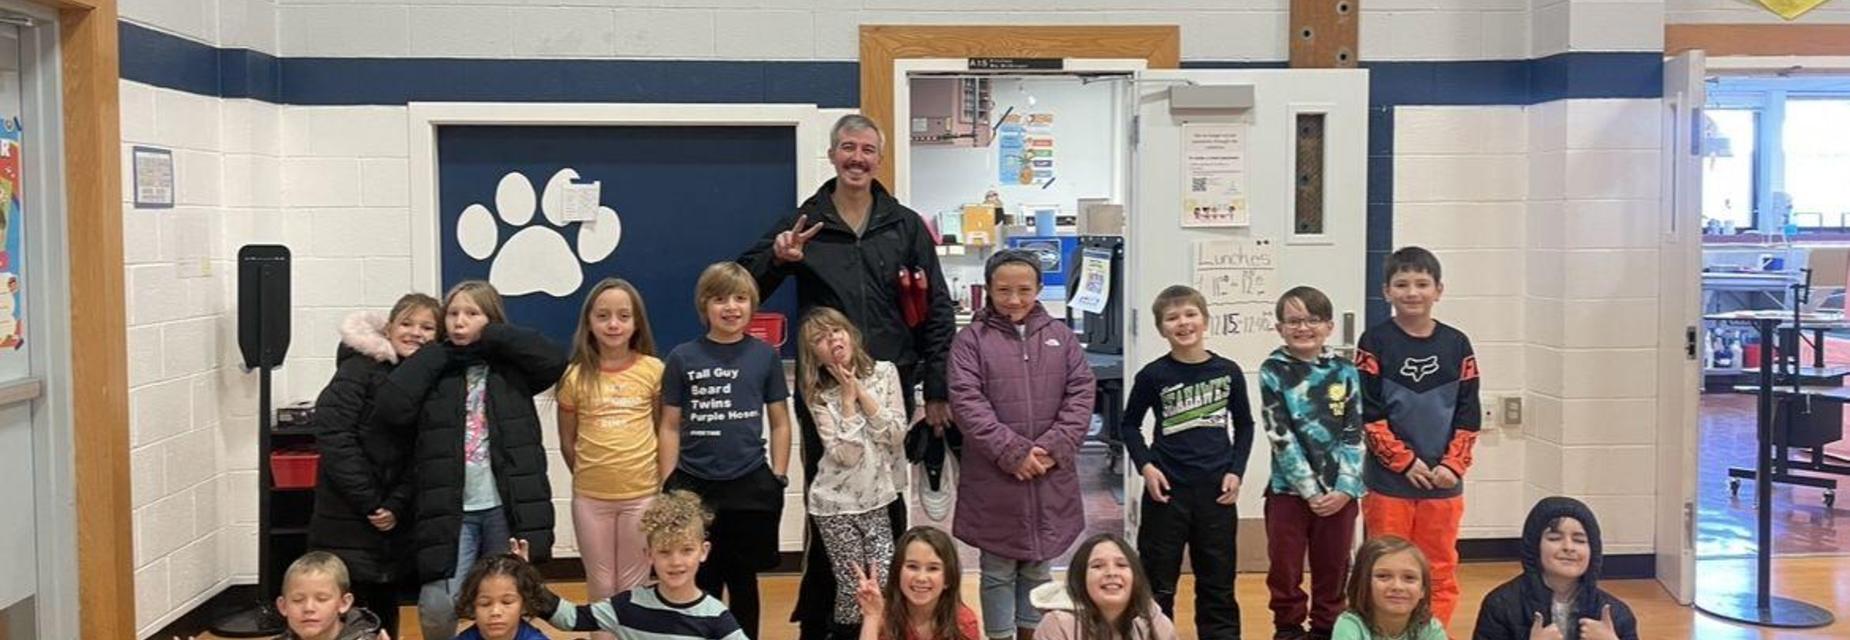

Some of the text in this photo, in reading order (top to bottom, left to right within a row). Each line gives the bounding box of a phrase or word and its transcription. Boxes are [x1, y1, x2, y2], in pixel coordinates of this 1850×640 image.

[1198, 243, 1271, 266] Lunches
[687, 367, 739, 380] Tall Guy
[691, 383, 732, 395] Beard
[690, 398, 732, 409] Twins
[690, 412, 725, 423] Purple
